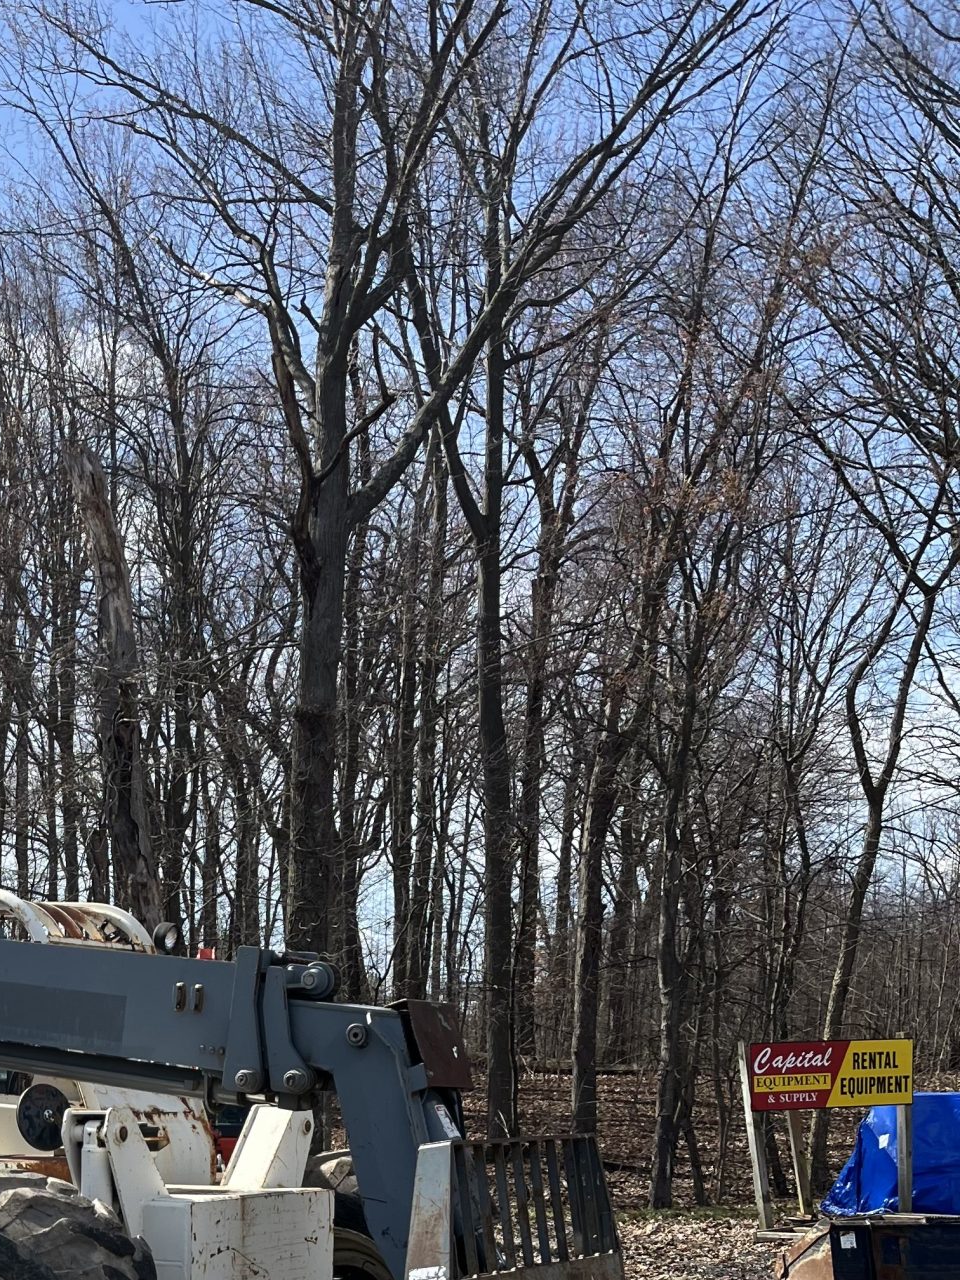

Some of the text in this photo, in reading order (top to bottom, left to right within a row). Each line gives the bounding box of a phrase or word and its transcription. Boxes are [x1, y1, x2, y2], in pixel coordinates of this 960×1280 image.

[754, 1047, 833, 1074] Capital
[852, 1051, 899, 1070] RENTAL
[756, 1075, 829, 1091] EQUIPMENT
[840, 1075, 910, 1098] EQUIPMENT
[767, 1092, 818, 1103] & SUPPLY
